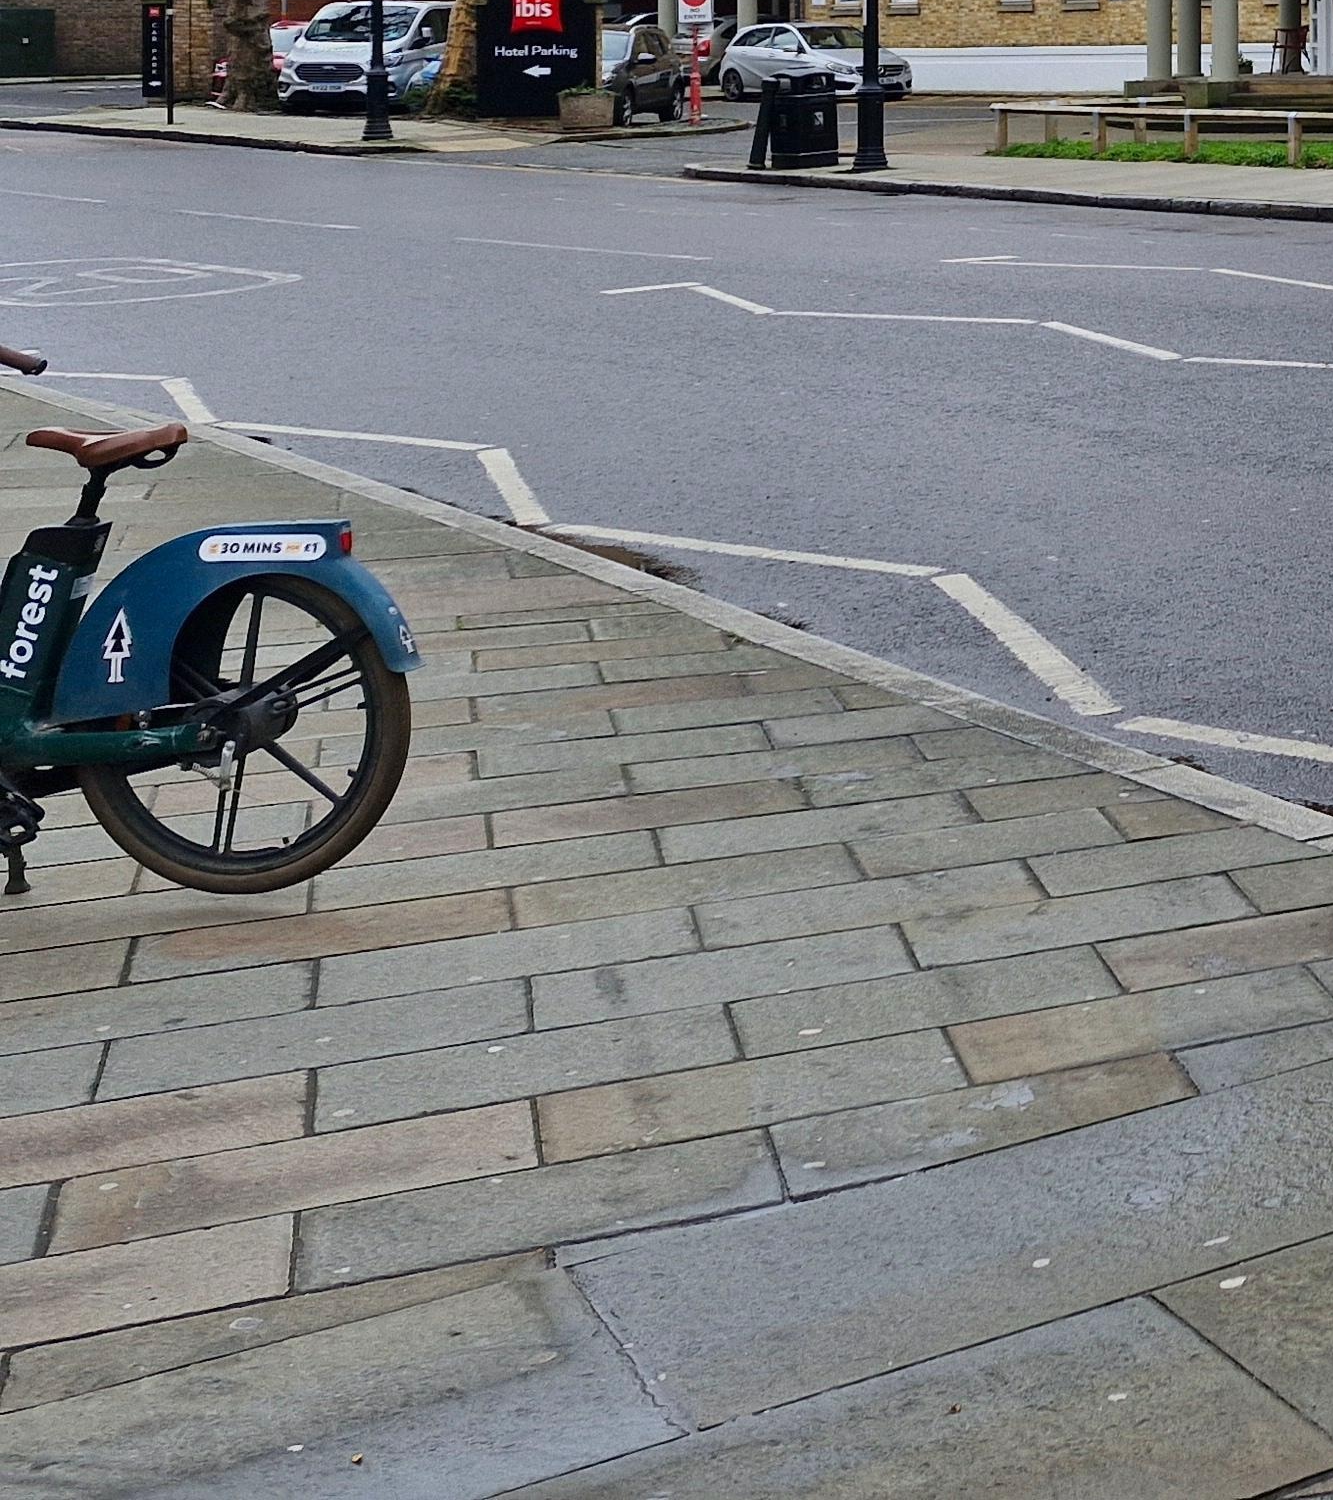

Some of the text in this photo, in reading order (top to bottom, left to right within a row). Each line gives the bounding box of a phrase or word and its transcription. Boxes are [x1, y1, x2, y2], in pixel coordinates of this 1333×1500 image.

[515, 0, 553, 18] ibis
[494, 44, 578, 59] Hotel Parking
[220, 542, 240, 554] 30
[242, 542, 282, 554] MINS
[303, 542, 318, 553] £1
[0, 564, 59, 679] forest
